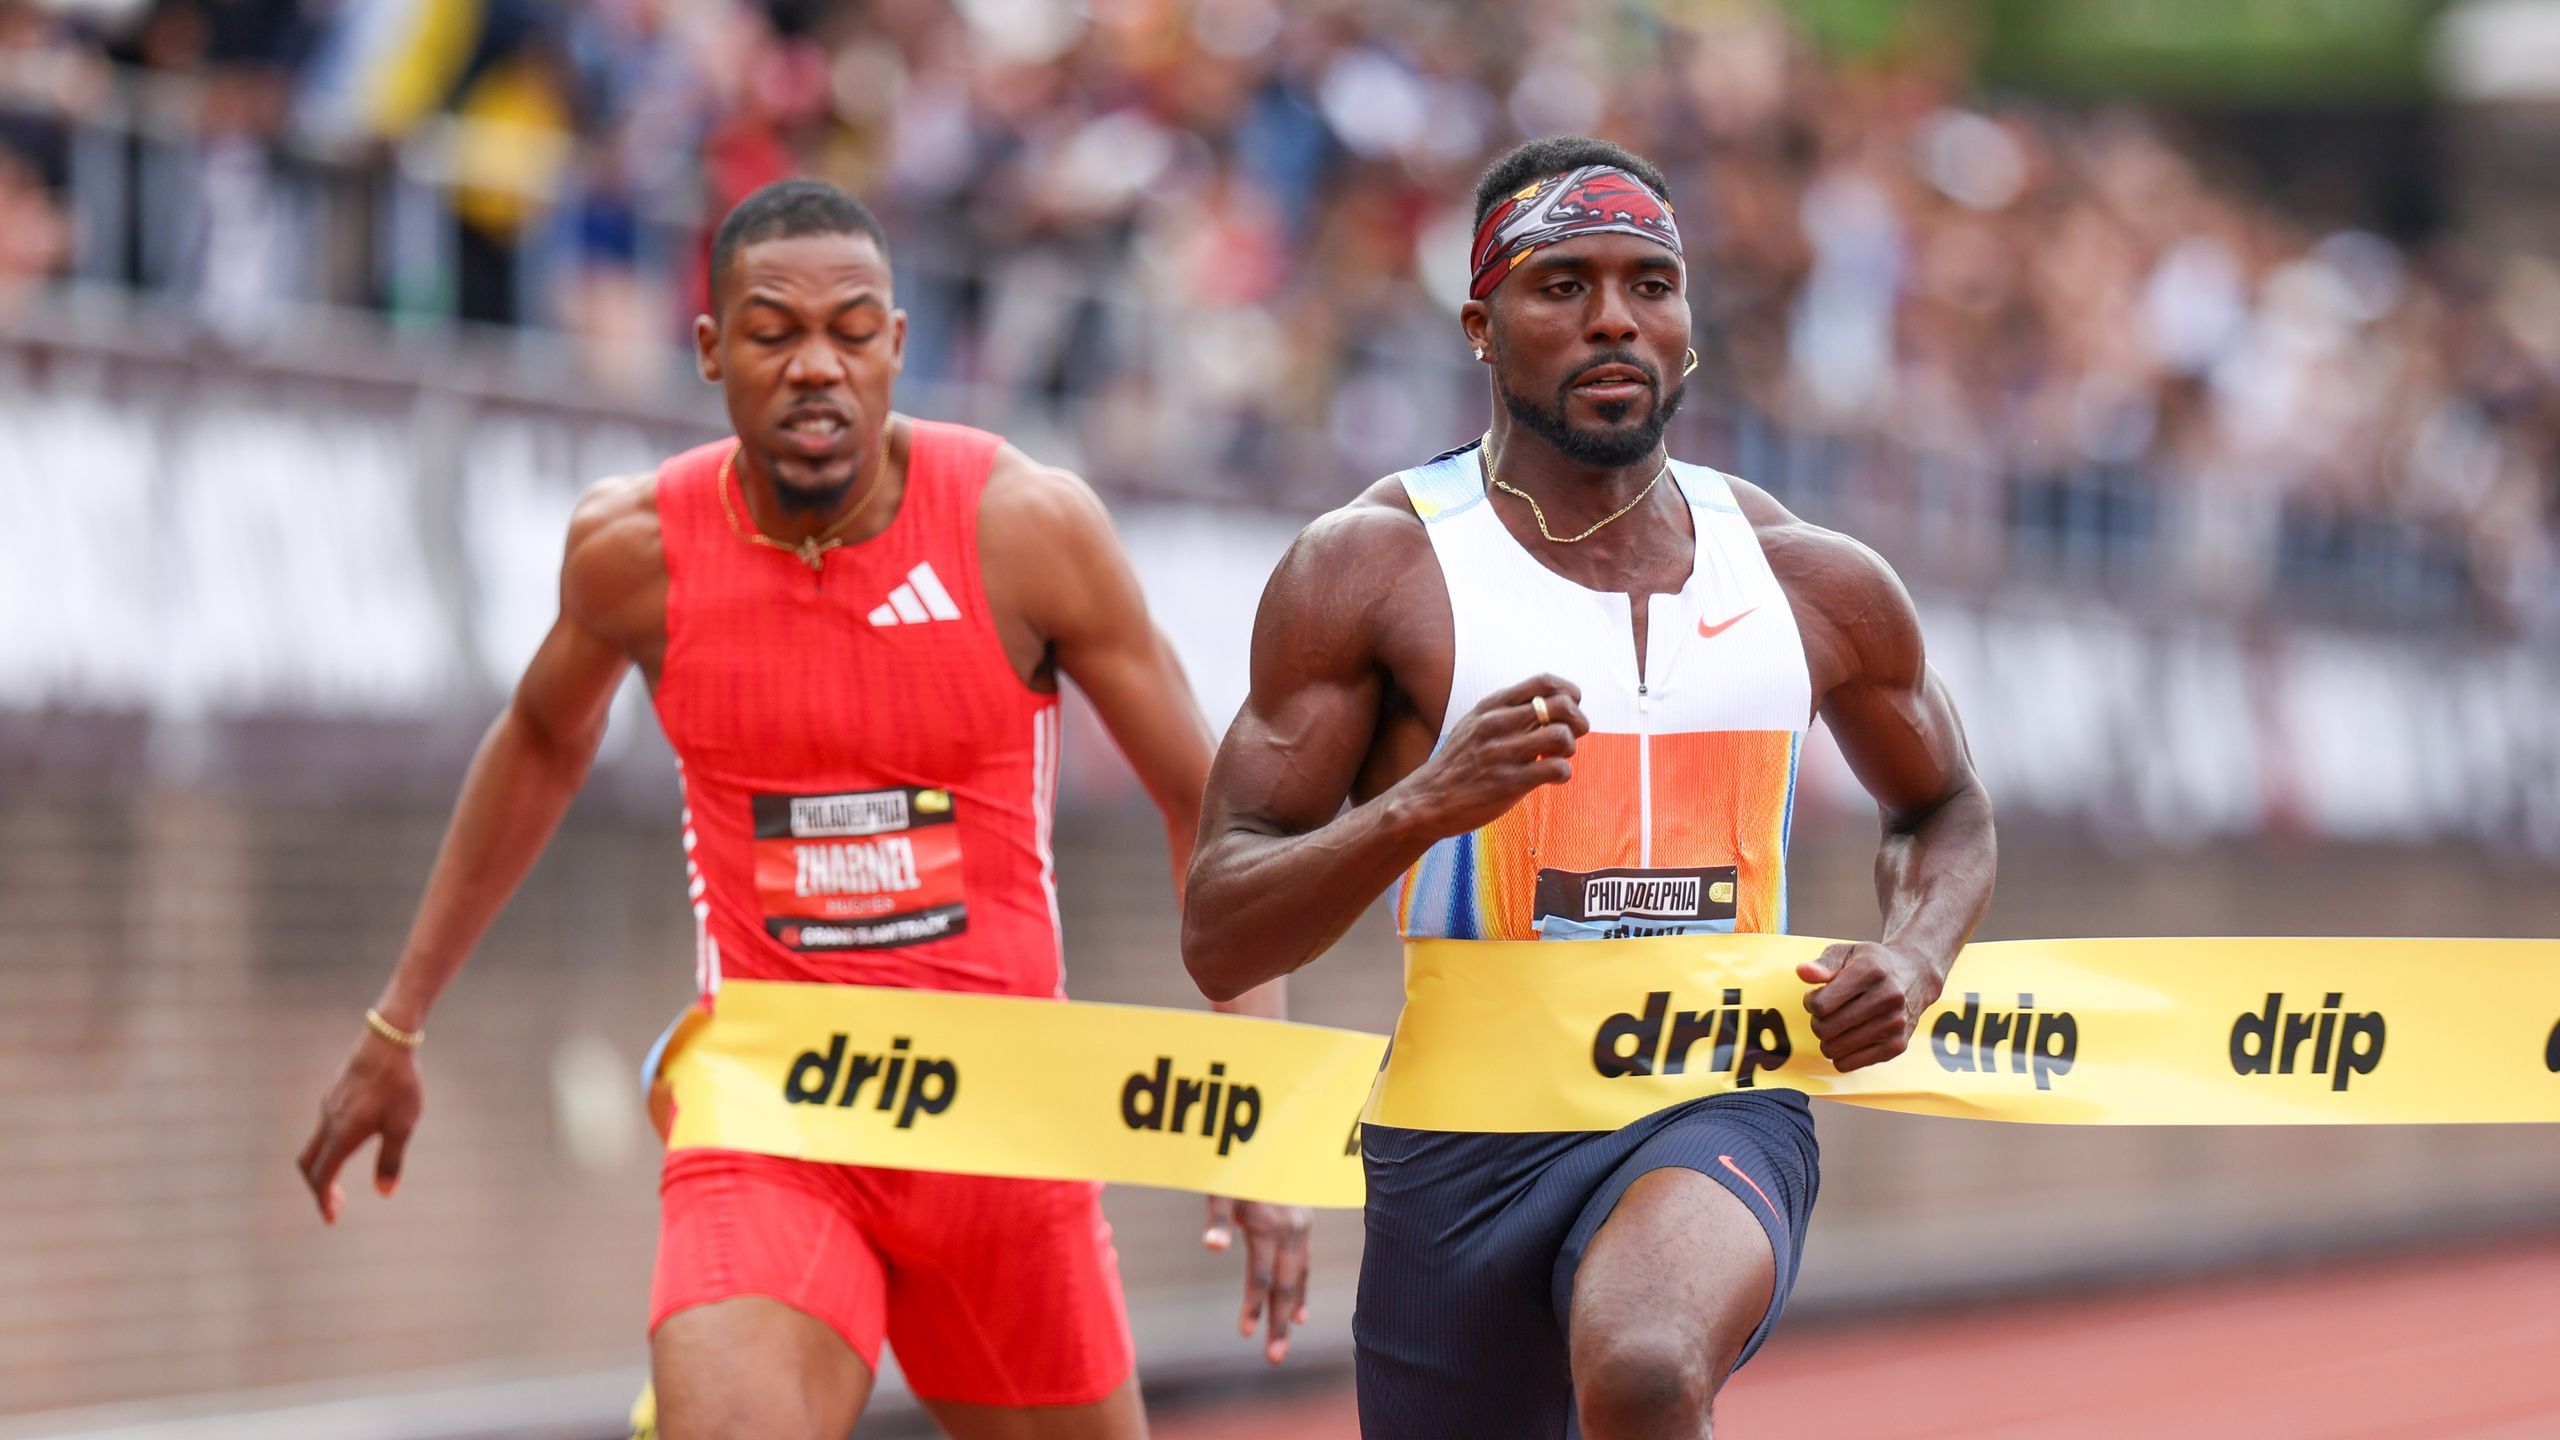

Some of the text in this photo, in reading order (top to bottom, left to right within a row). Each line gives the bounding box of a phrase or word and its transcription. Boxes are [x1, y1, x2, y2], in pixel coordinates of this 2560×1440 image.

[798, 799, 903, 828] PHILADELPHIA
[794, 837, 921, 896] ZHARNEL
[1587, 880, 1696, 912] PHILADELPHIA
[784, 1034, 960, 1129] drip
[1592, 988, 1793, 1088] drip
[1930, 992, 2078, 1090] drip
[2228, 992, 2386, 1092] drip
[1120, 1056, 1262, 1156] drip
